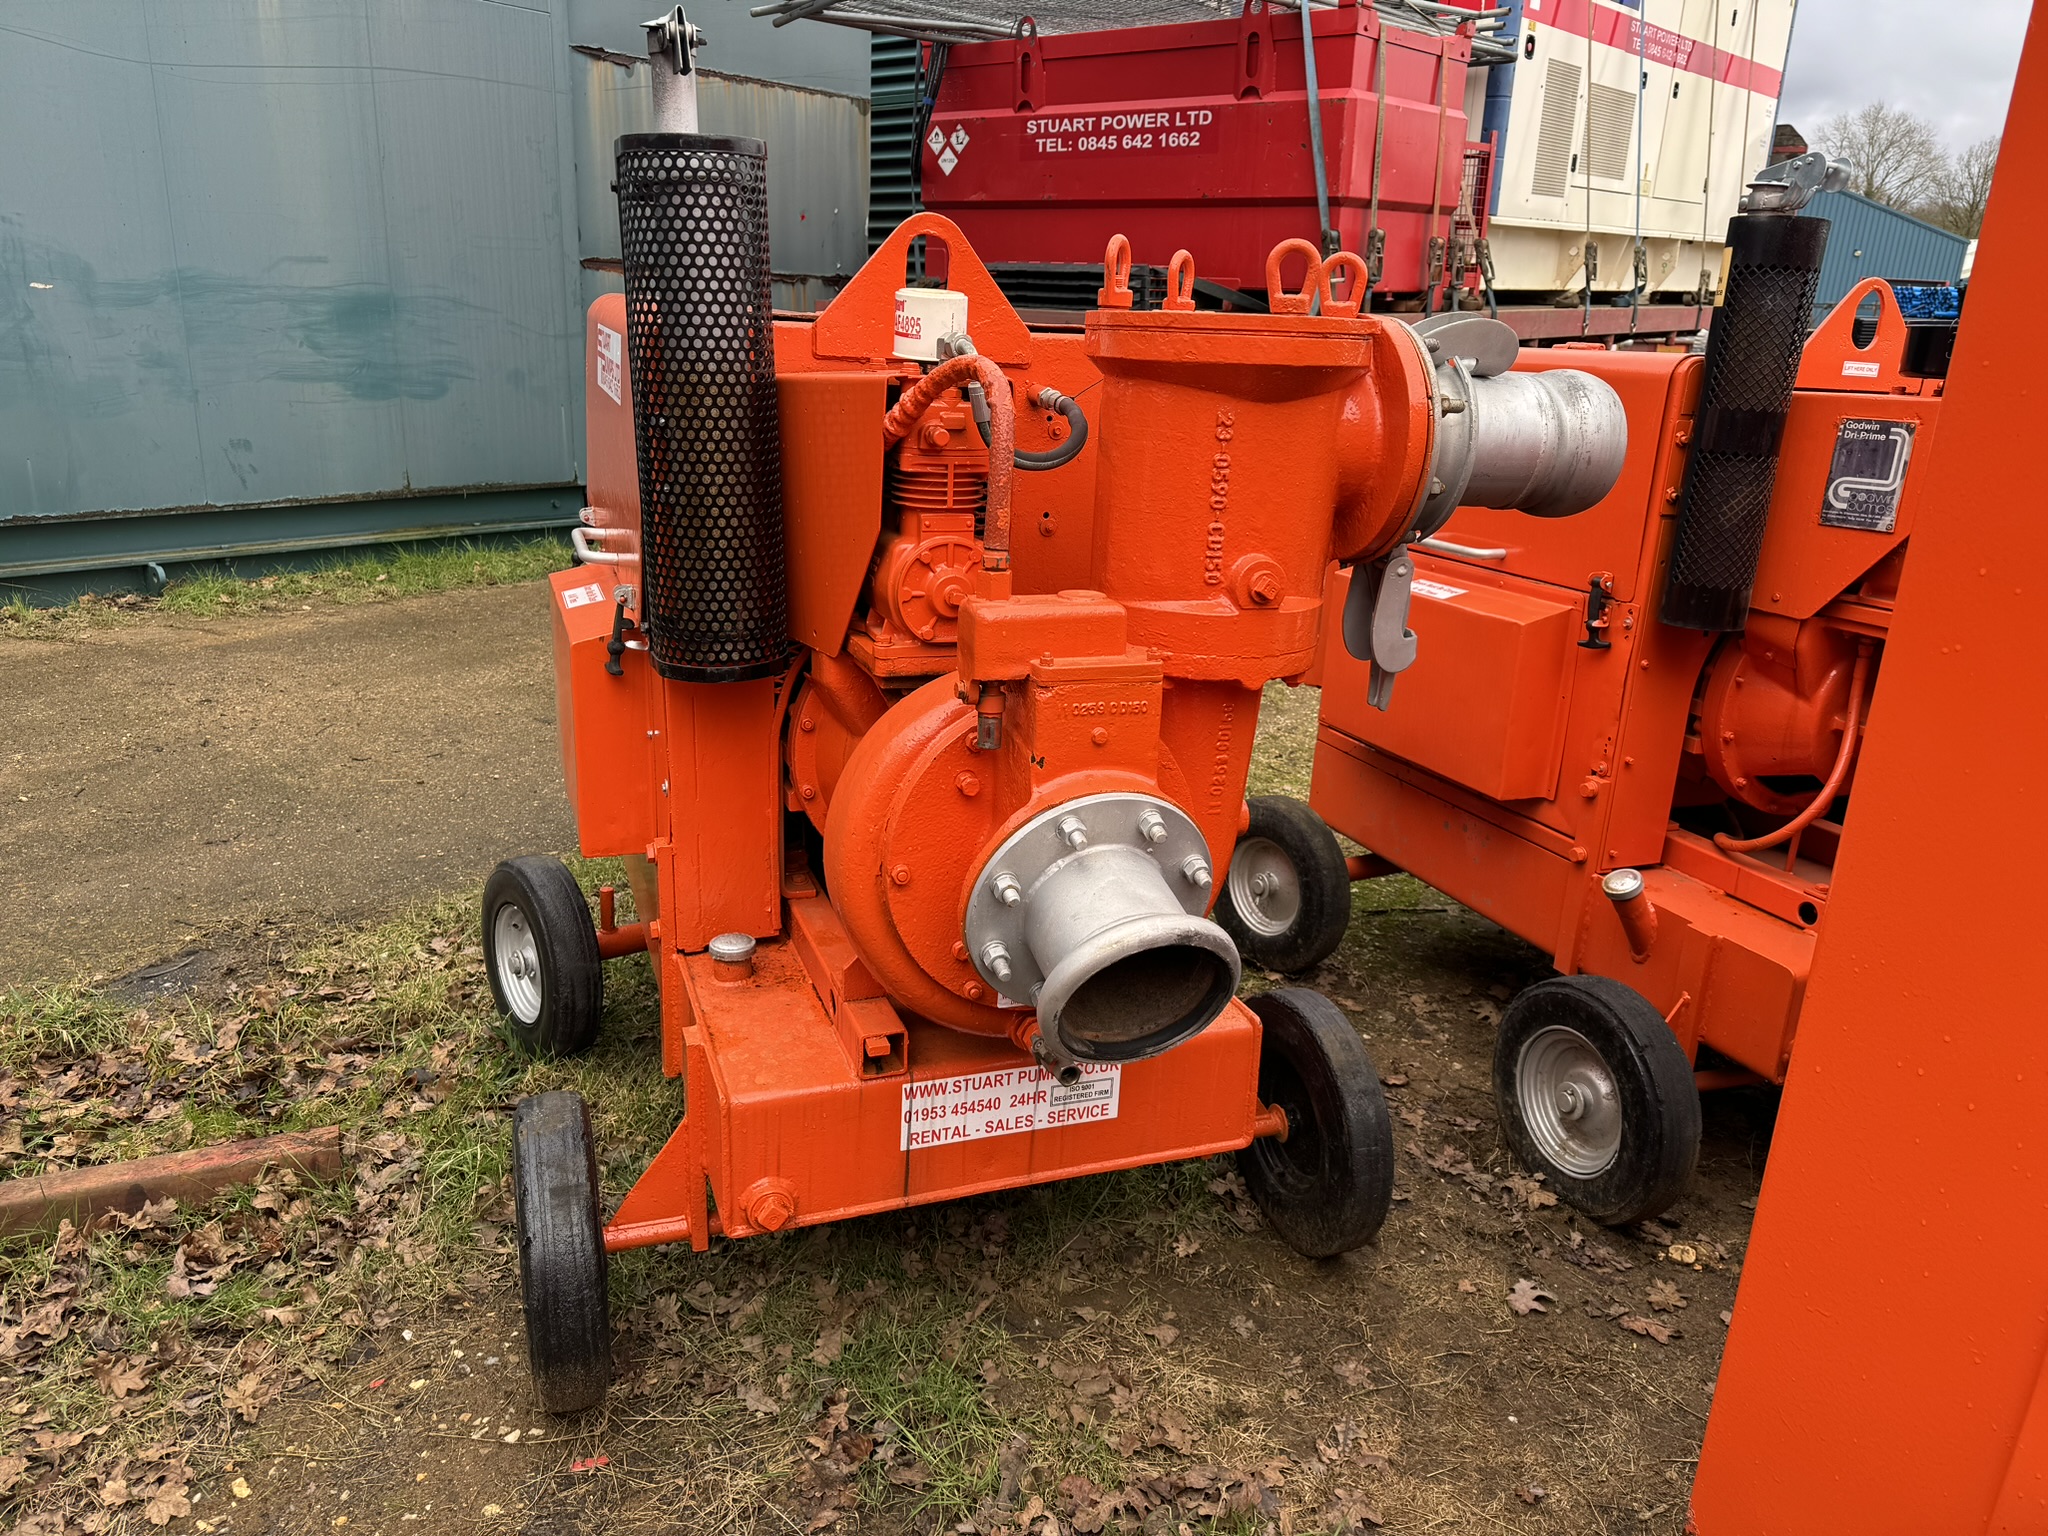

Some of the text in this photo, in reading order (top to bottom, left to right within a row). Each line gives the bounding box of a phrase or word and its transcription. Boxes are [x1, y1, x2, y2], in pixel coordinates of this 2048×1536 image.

[1632, 37, 1647, 52] TE:
[1026, 110, 1213, 135] STUART POWER LTD
[1035, 131, 1201, 153] TEL: 0845 642 1662
[1846, 420, 1880, 431] Godwin
[1844, 430, 1886, 441] Dri-Prime
[904, 1072, 1014, 1101] WWW.STUART
[1054, 1088, 1110, 1103] REGISTERED FIRM
[1069, 1083, 1095, 1092] ISO 9001
[904, 1090, 1047, 1124] 01953 454540 24HR
[910, 1125, 971, 1146] RENTAL
[984, 1114, 1034, 1134] SALES
[1047, 1103, 1110, 1124] SERVICE
